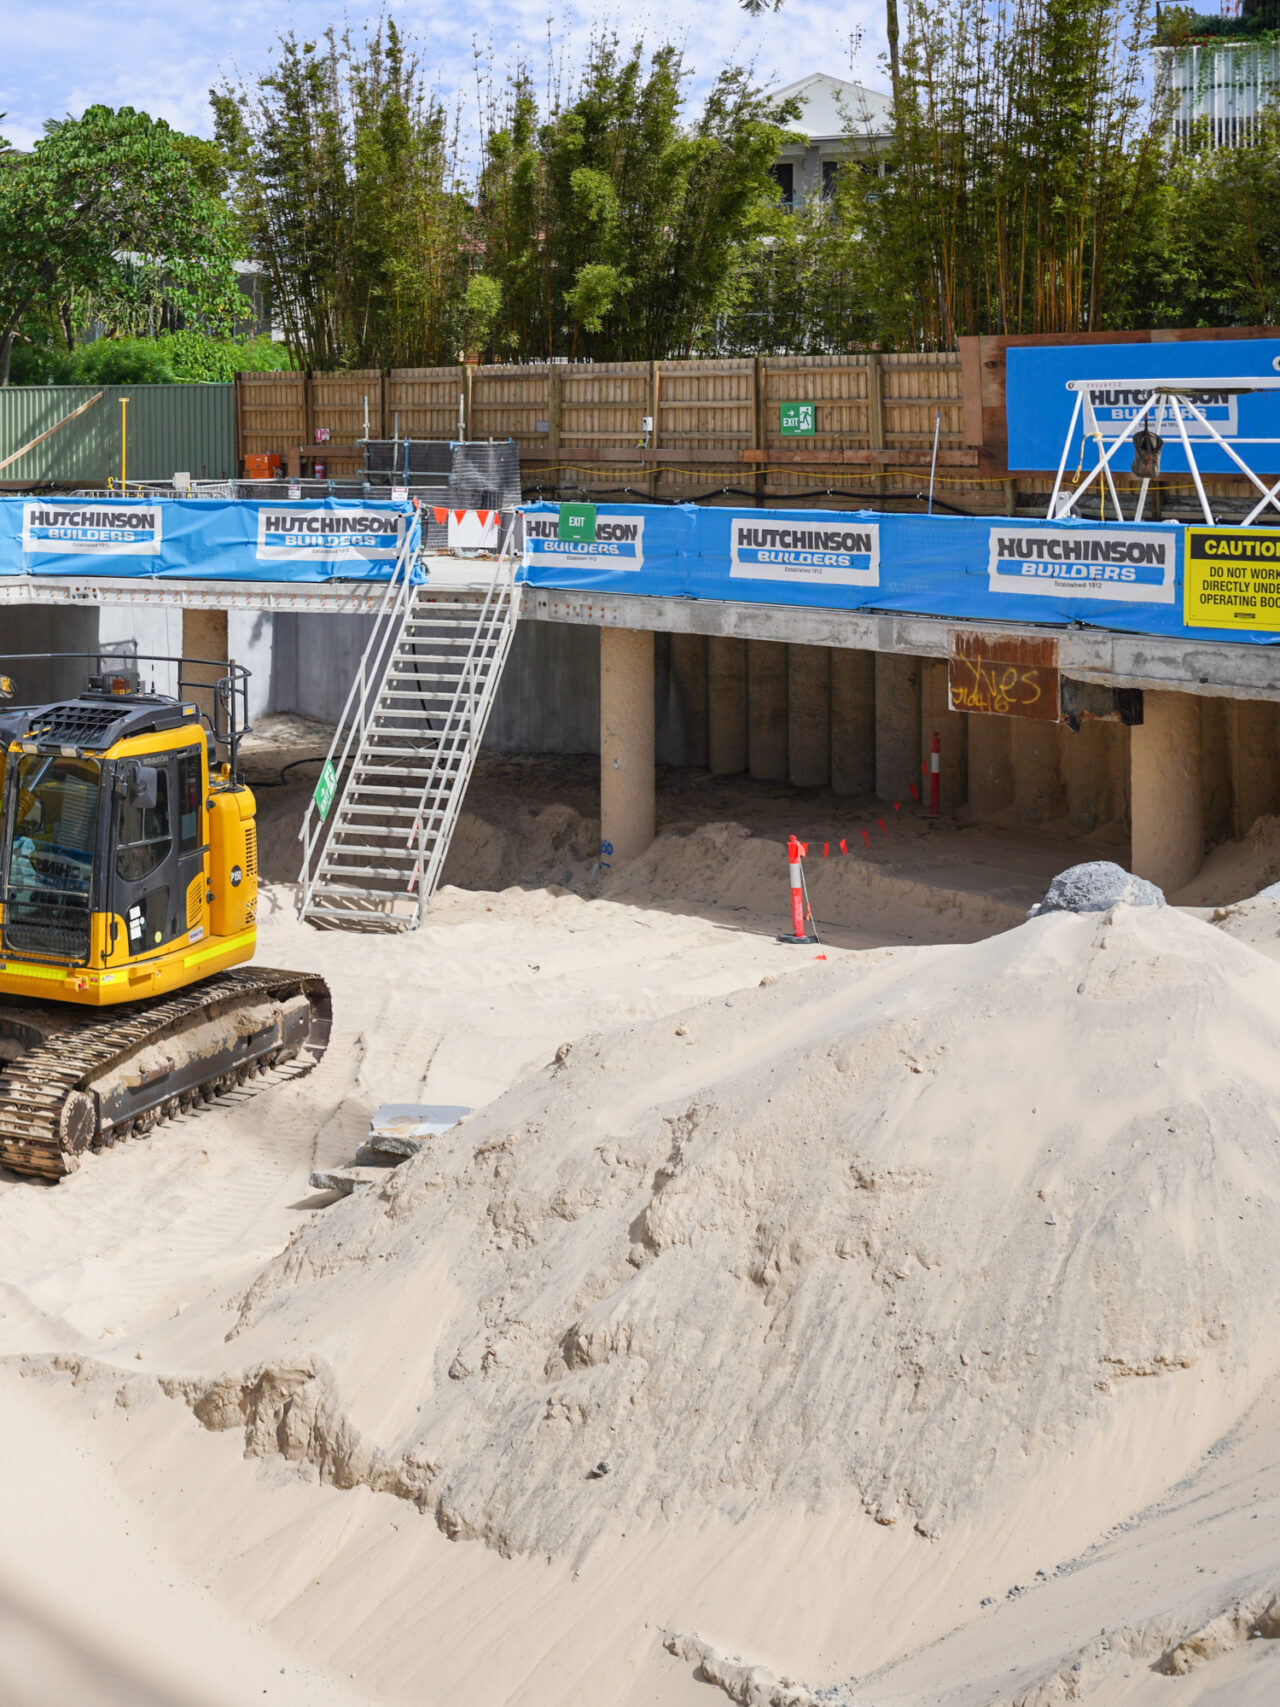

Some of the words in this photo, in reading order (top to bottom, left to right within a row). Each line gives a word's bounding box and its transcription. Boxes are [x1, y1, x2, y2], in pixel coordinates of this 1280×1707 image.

[783, 417, 799, 427] EXIT
[30, 510, 155, 529] HUTCHINSON
[265, 515, 399, 534] HUTCHINSON
[569, 516, 585, 527] EXIT
[48, 528, 135, 542] BUILDERS
[526, 520, 638, 541] HUTNSON
[285, 533, 376, 547] BUILDERS
[738, 527, 872, 552] HUTCHINSON
[543, 541, 620, 554] BUILDERS
[997, 537, 1165, 565] HUTCHINSON
[757, 550, 850, 566] BUILDERS
[784, 566, 811, 574] Established
[1021, 562, 1136, 581] BUILDERS
[1210, 566, 1224, 578] DO
[1227, 567, 1247, 579] NOT
[1054, 580, 1087, 589] Established
[1202, 580, 1250, 593] DIRECTLY
[1253, 582, 1280, 594] UNDE
[1200, 593, 1257, 607] OPERATING
